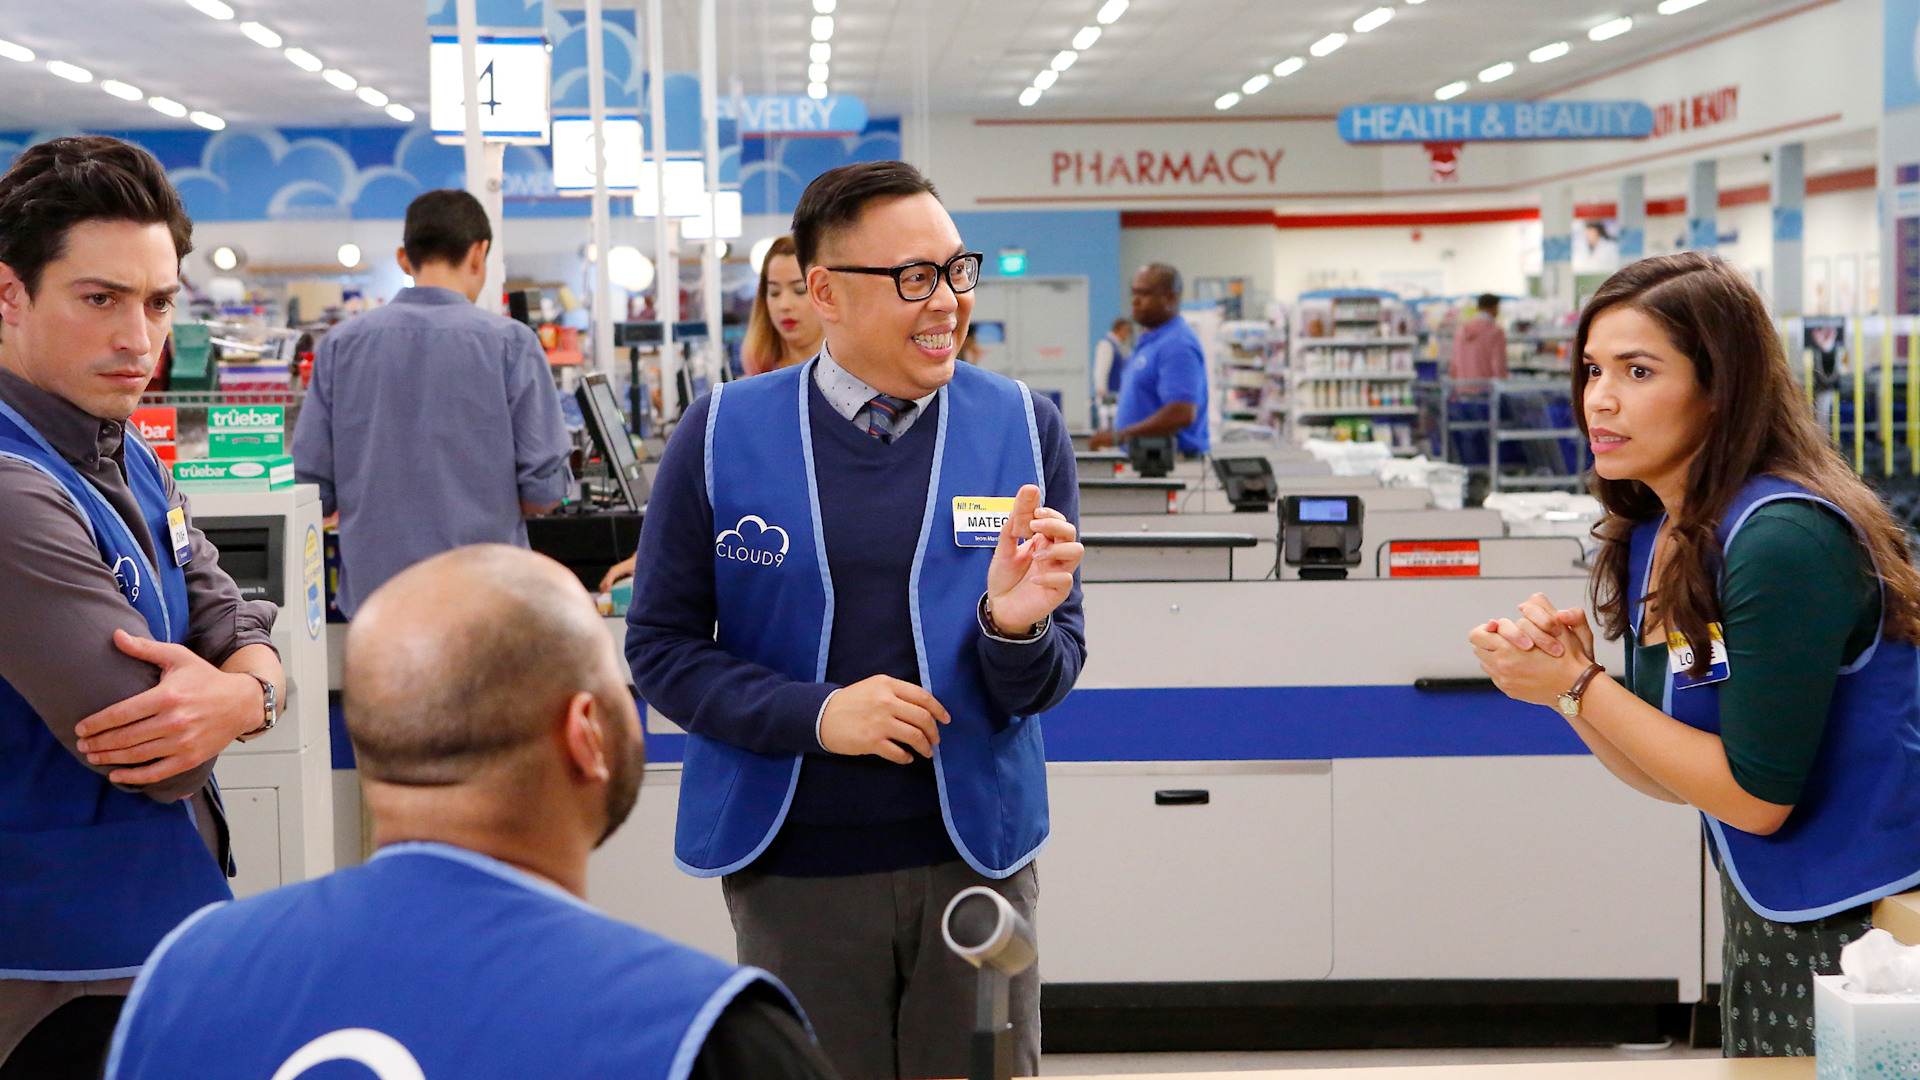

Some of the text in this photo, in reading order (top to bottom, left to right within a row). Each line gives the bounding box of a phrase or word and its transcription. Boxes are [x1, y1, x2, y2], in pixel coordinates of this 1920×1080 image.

[461, 59, 502, 116] 4
[1352, 101, 1637, 139] HEALTH & BEAUTY
[1052, 149, 1284, 186] PHARMACY
[716, 543, 784, 568] CLOUD9
